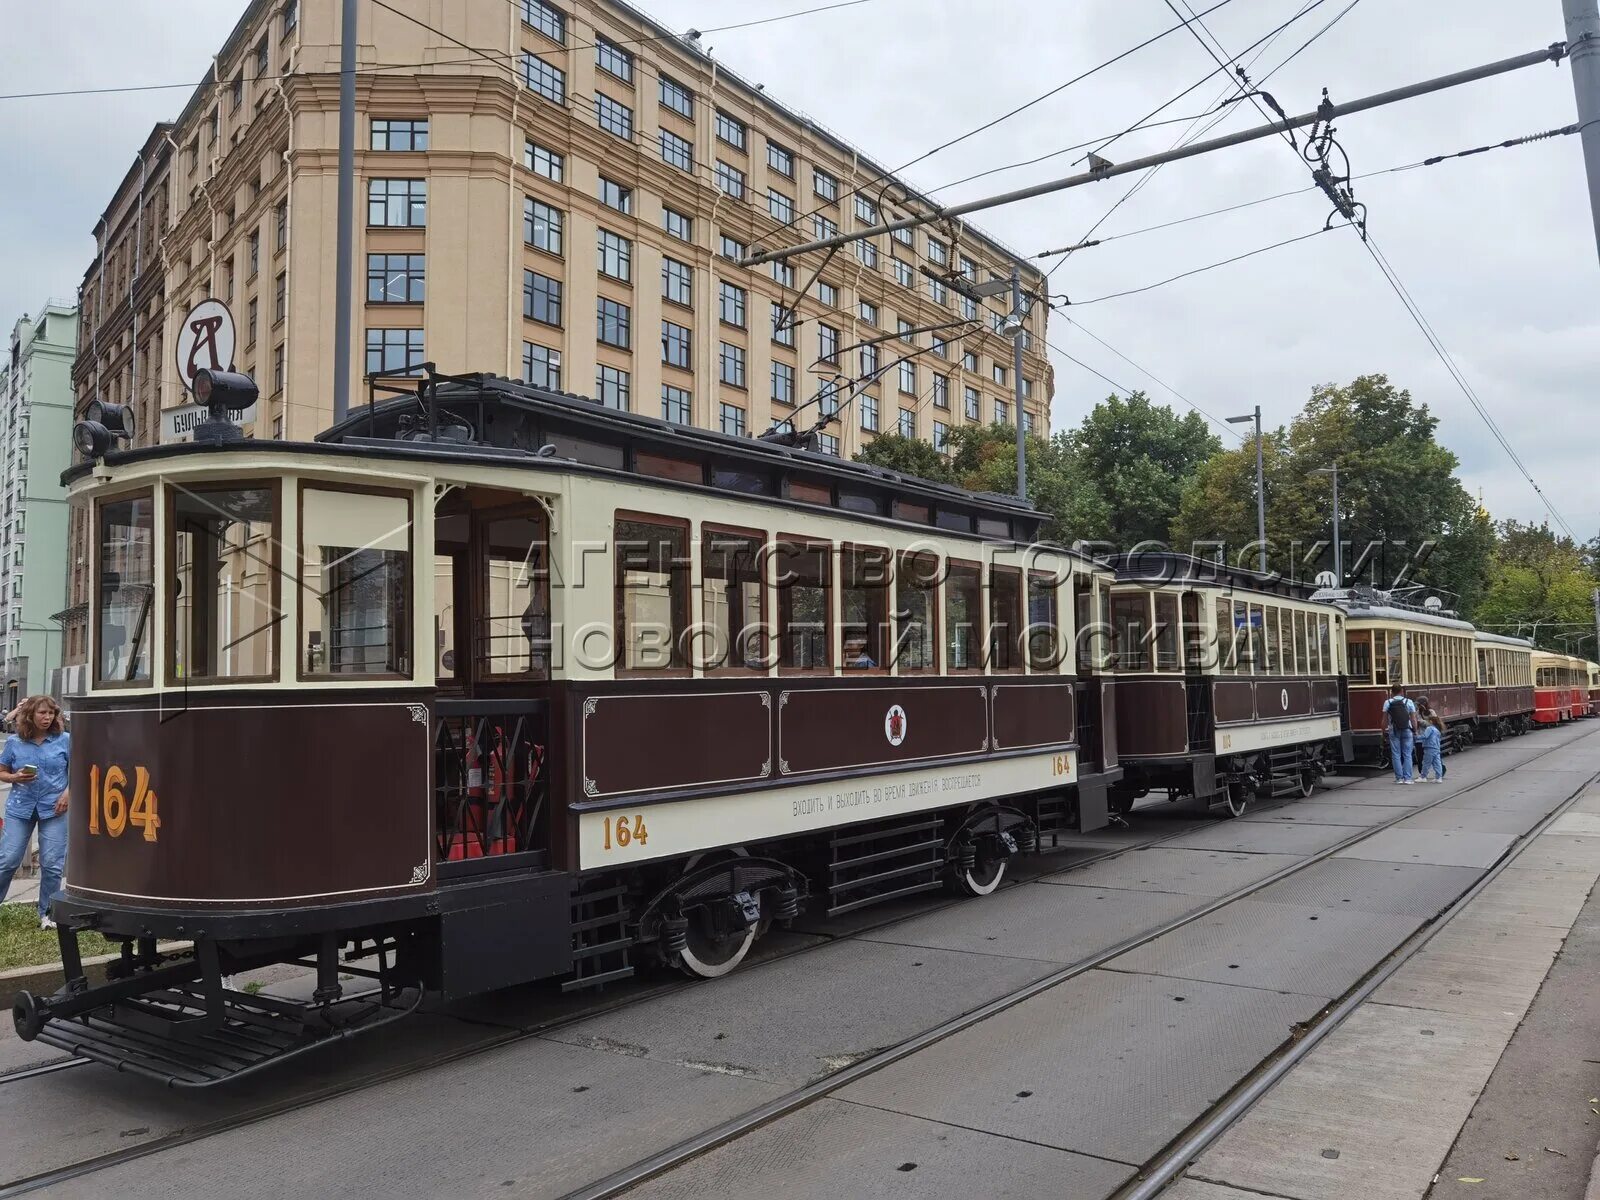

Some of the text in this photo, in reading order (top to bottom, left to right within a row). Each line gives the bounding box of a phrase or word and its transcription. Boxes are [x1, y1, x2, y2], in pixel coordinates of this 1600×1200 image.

[1052, 755, 1070, 776] 164
[89, 764, 161, 842] 164
[793, 797, 825, 817] ВХОДИТЬ
[827, 795, 833, 811] И
[836, 790, 870, 809] ВЫХОДИТЬ
[873, 788, 882, 803] ВО
[884, 784, 906, 801] ВРЕМЯ
[603, 814, 649, 851] 164
